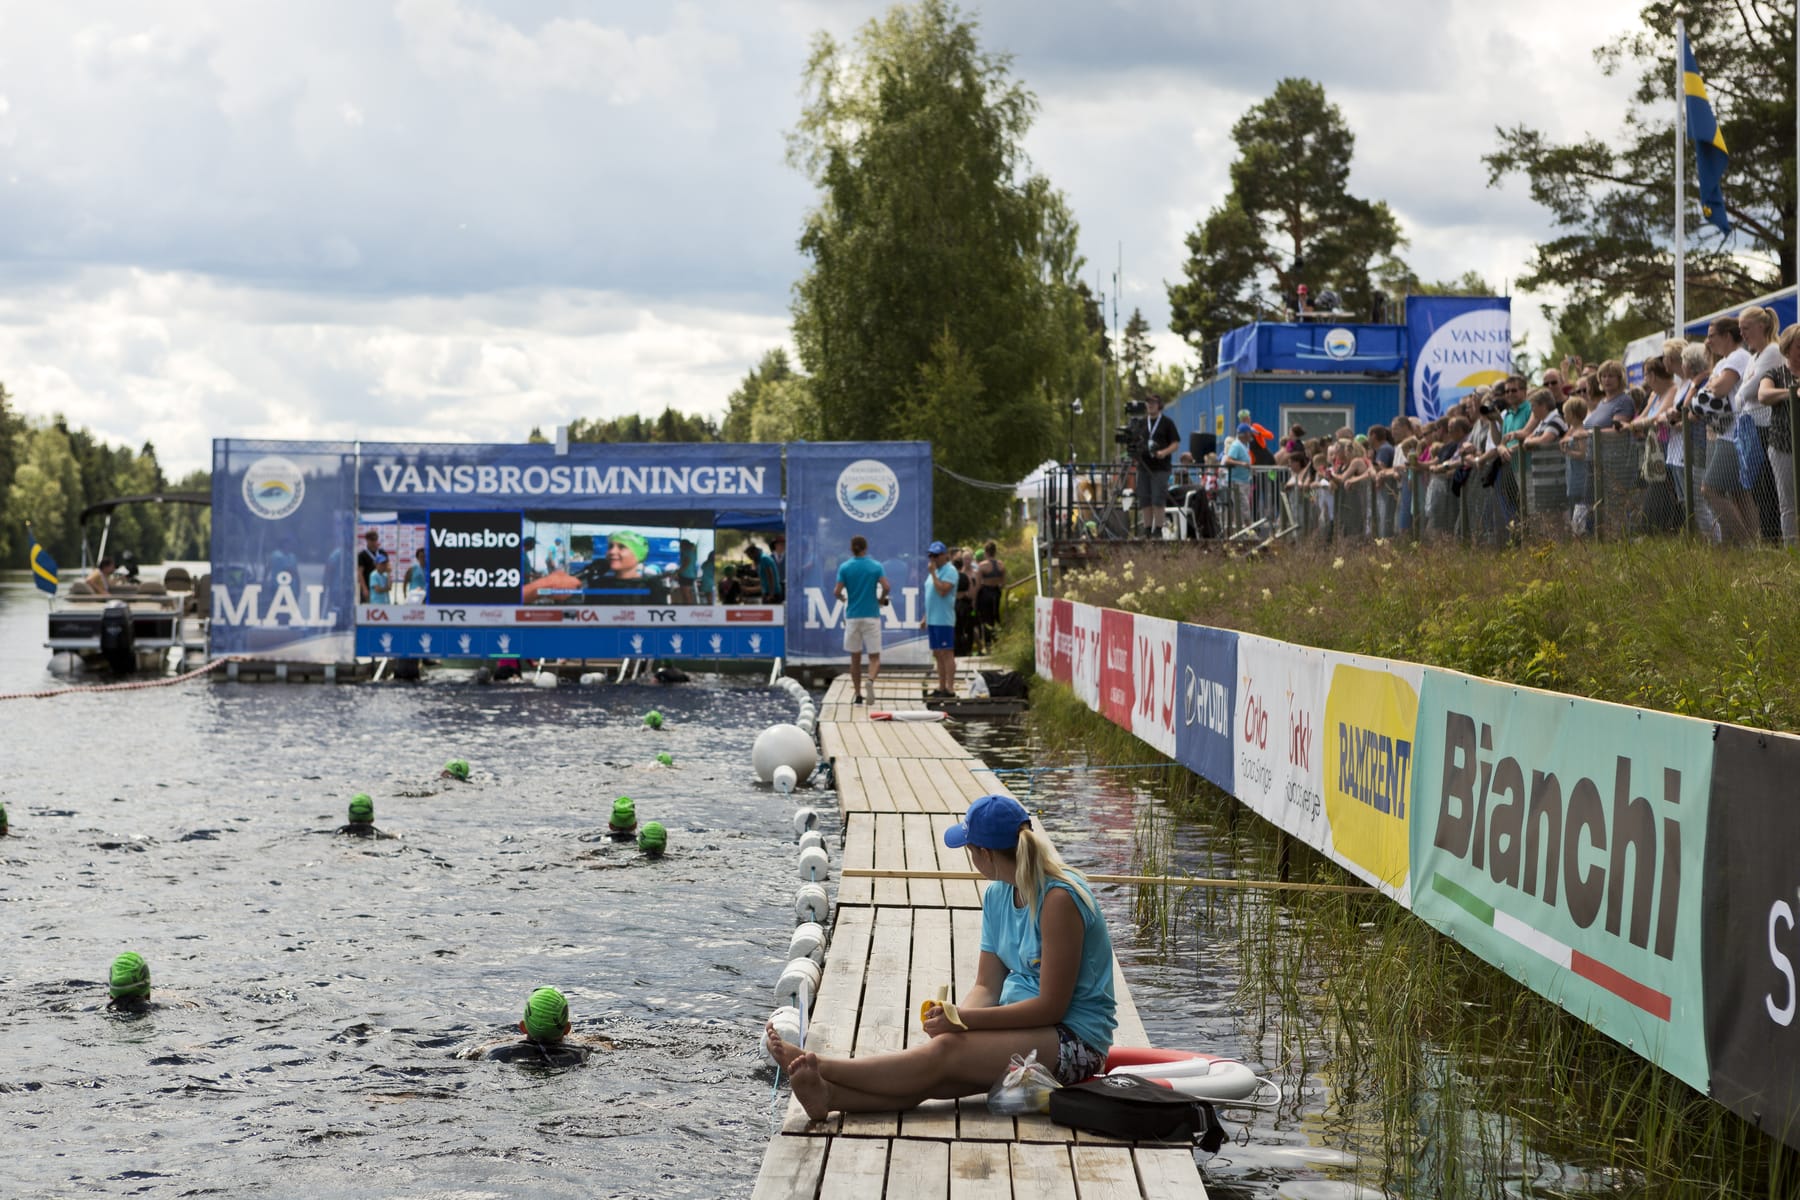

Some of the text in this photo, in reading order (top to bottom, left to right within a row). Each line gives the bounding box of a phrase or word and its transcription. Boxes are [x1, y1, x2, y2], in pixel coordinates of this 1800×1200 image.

[373, 464, 766, 496] VANSBROSIMNINGEN
[430, 528, 520, 549] Vansbro
[430, 568, 520, 588] 12:50:29
[211, 572, 337, 628] MÅL
[366, 609, 389, 621] ICA
[437, 609, 467, 623] TYR
[575, 609, 599, 622] ICA
[647, 609, 677, 623] TYR
[1339, 721, 1411, 819] RAMIRENT
[1434, 710, 1682, 961] Bianchi
